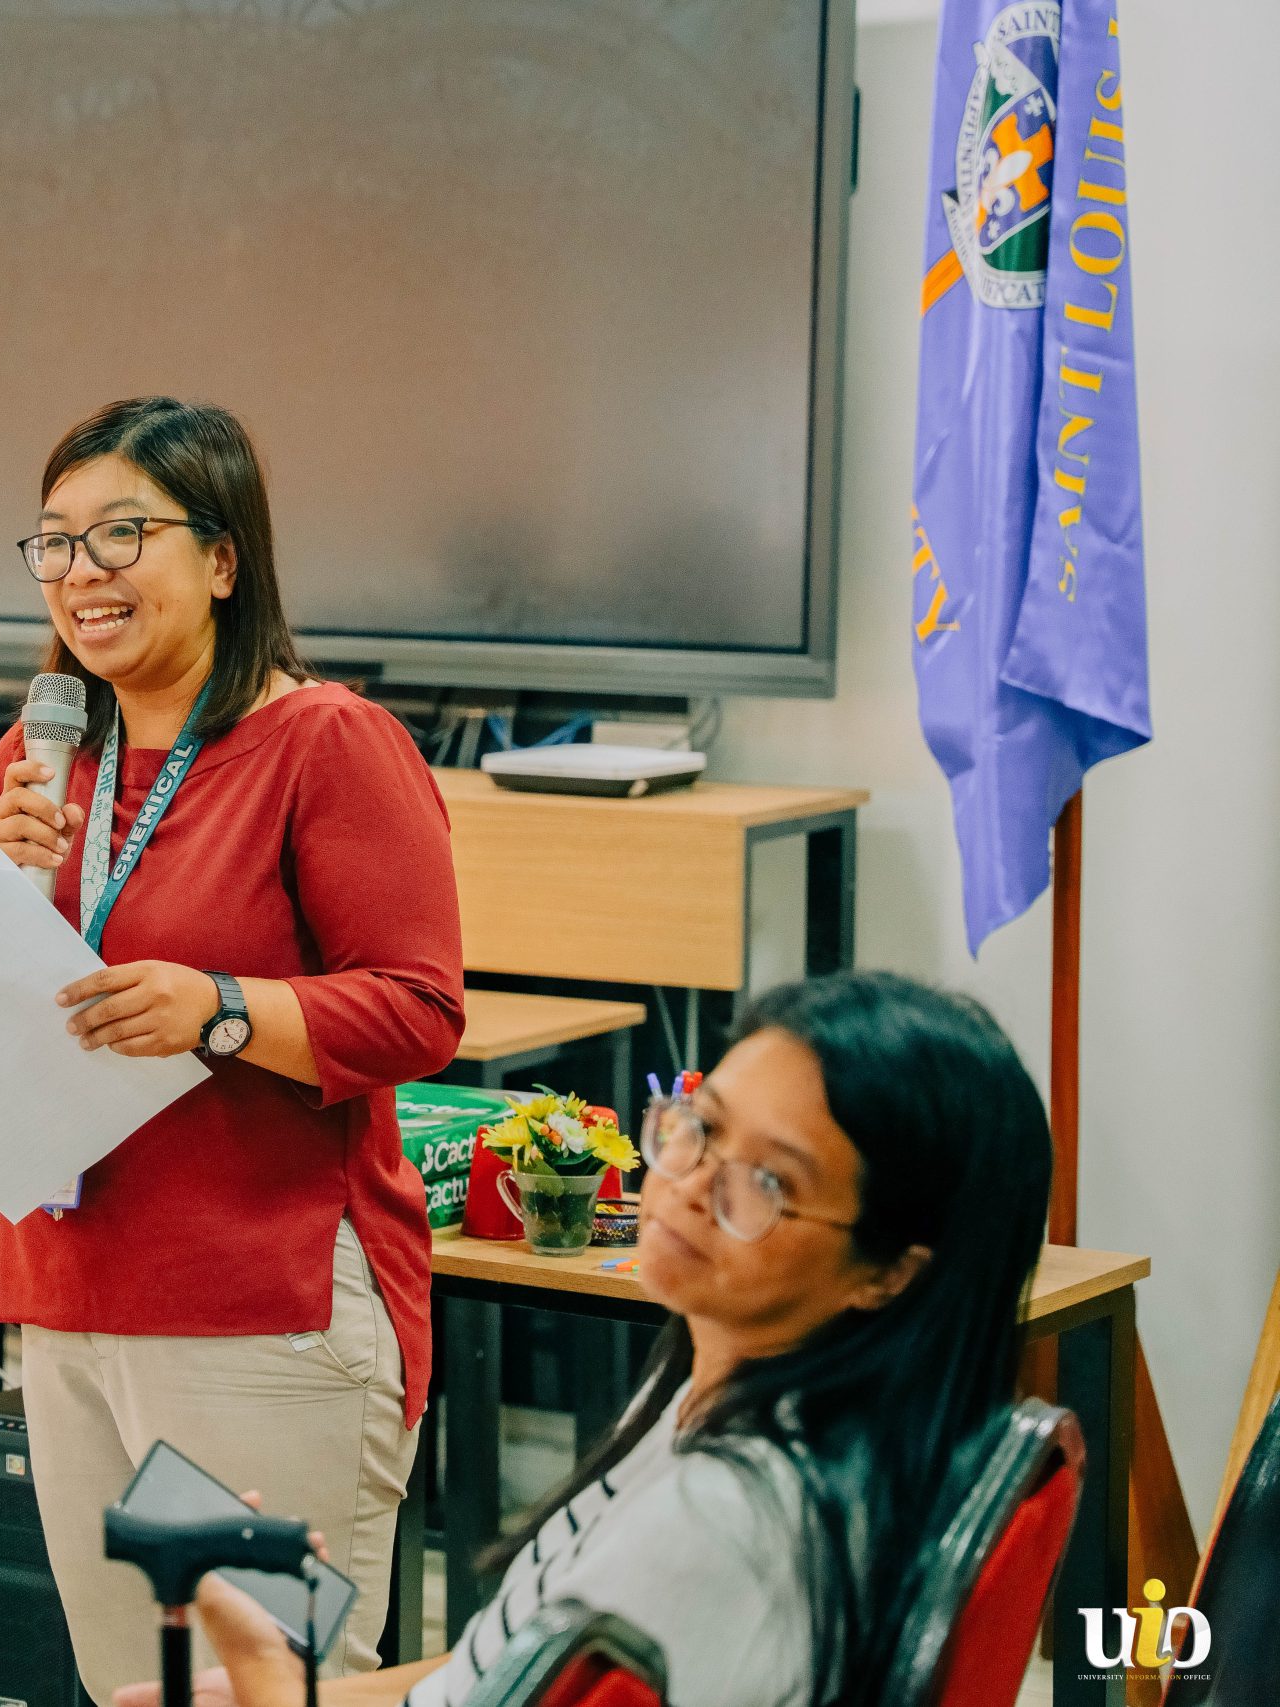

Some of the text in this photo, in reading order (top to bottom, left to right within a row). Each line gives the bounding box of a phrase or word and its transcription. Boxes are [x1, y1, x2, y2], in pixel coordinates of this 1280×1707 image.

[1064, 69, 1127, 332] LOUIS
[114, 744, 194, 881] CHEMICAL
[425, 1176, 471, 1214] actu
[434, 1132, 477, 1172] Cact
